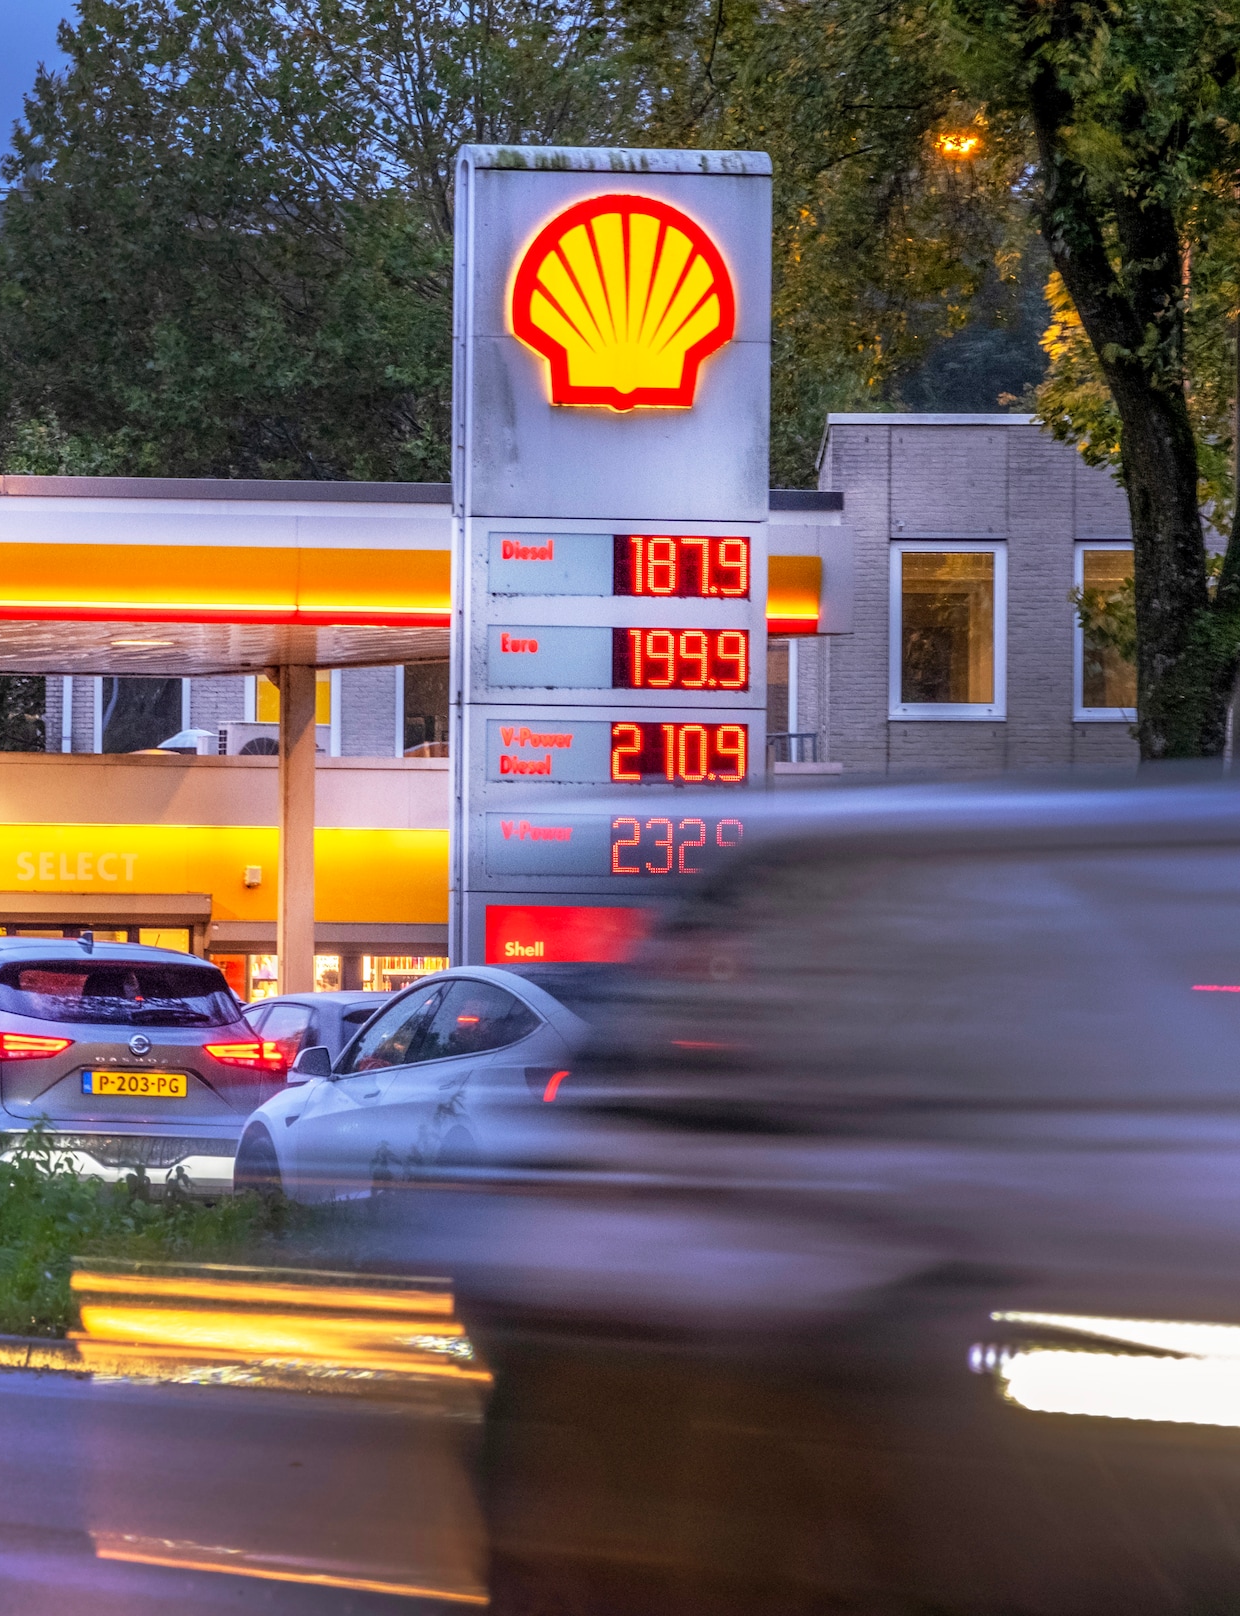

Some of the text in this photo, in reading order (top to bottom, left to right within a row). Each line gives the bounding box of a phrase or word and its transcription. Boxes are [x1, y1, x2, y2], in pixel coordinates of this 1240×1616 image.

[502, 539, 554, 560] Diesel
[501, 632, 539, 653] Euro
[501, 726, 573, 748] V-Power
[500, 754, 552, 775] Diesel
[501, 820, 573, 842] V-Power
[16, 852, 139, 881] SELECT
[505, 941, 545, 957] Shell
[99, 1076, 179, 1093] P-203-PG
